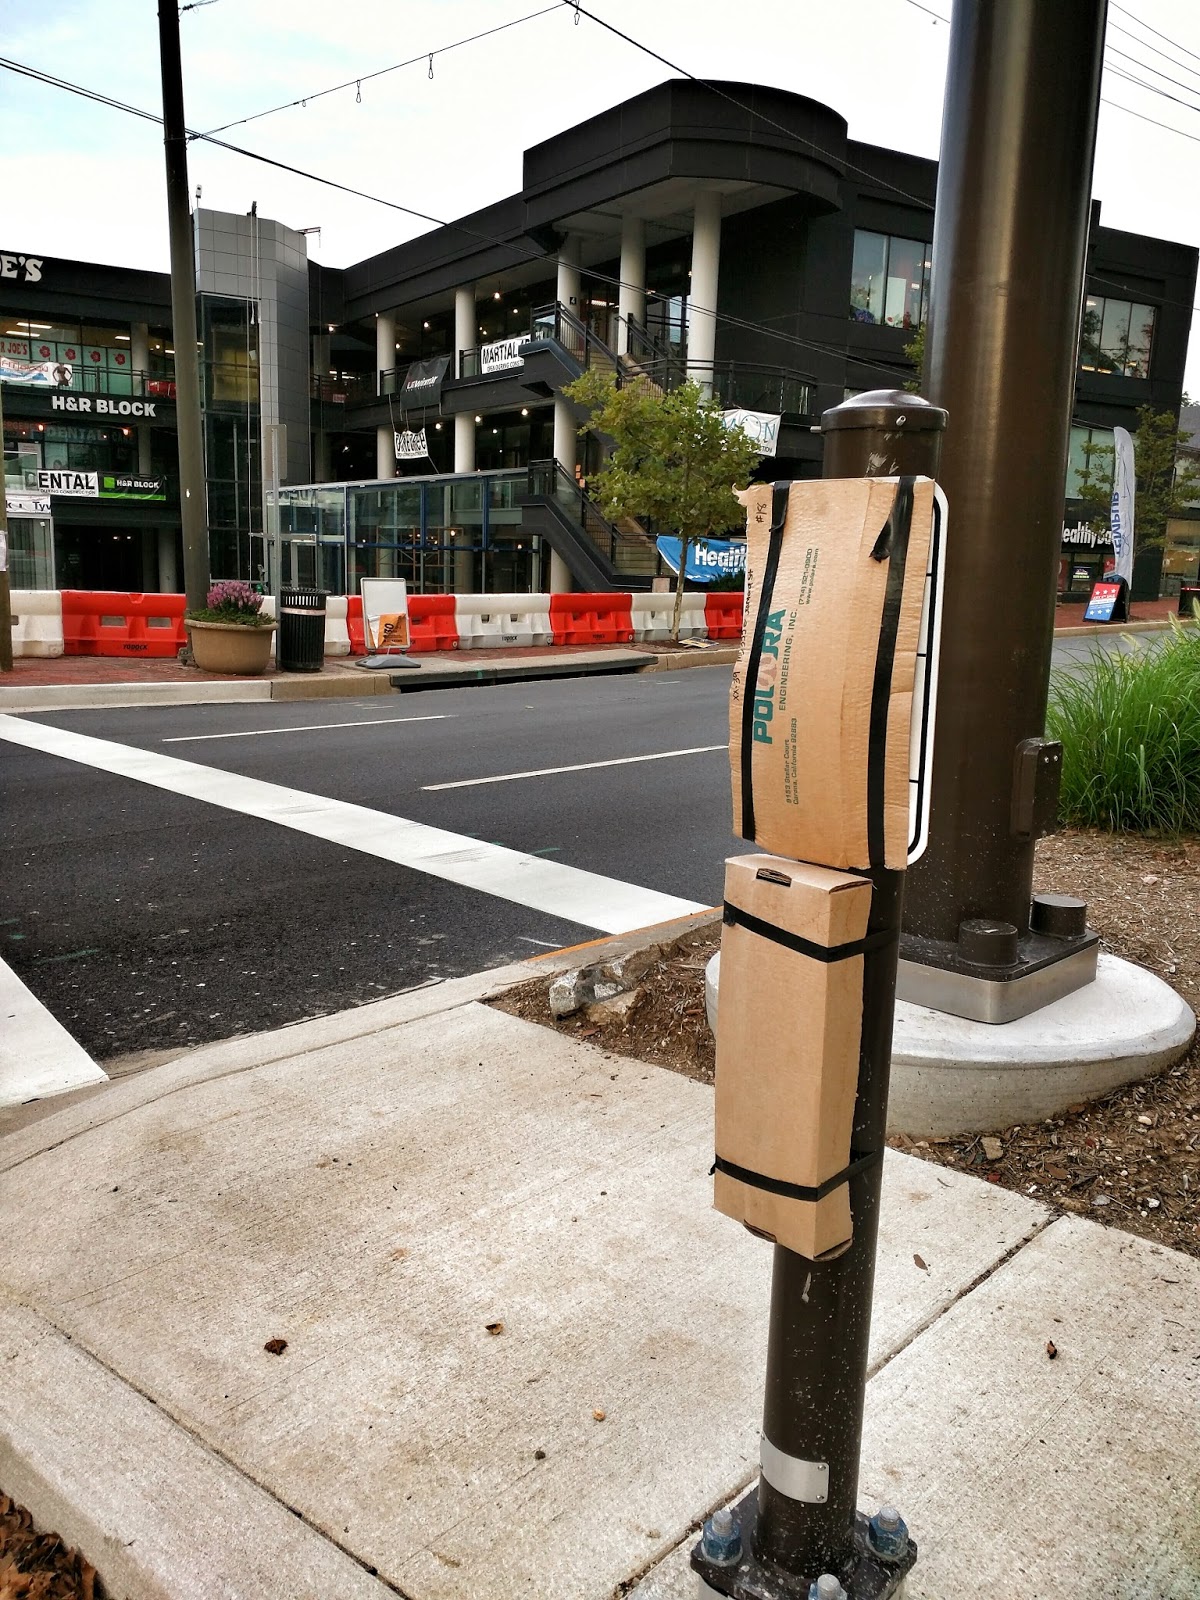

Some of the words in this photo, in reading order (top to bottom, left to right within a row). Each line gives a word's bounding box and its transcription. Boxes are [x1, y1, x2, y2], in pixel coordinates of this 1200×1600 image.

[0, 255, 43, 282] E'S
[8, 342, 27, 355] JOE'S
[482, 341, 518, 364] MARTIAL
[52, 396, 92, 412] H&R
[97, 400, 156, 417] BLOCK
[801, 548, 813, 585] 521-0900
[805, 548, 819, 605] www.polara.com
[798, 585, 807, 605] (714)
[779, 632, 794, 711] ENGINEERING,
[788, 608, 798, 631] INC.
